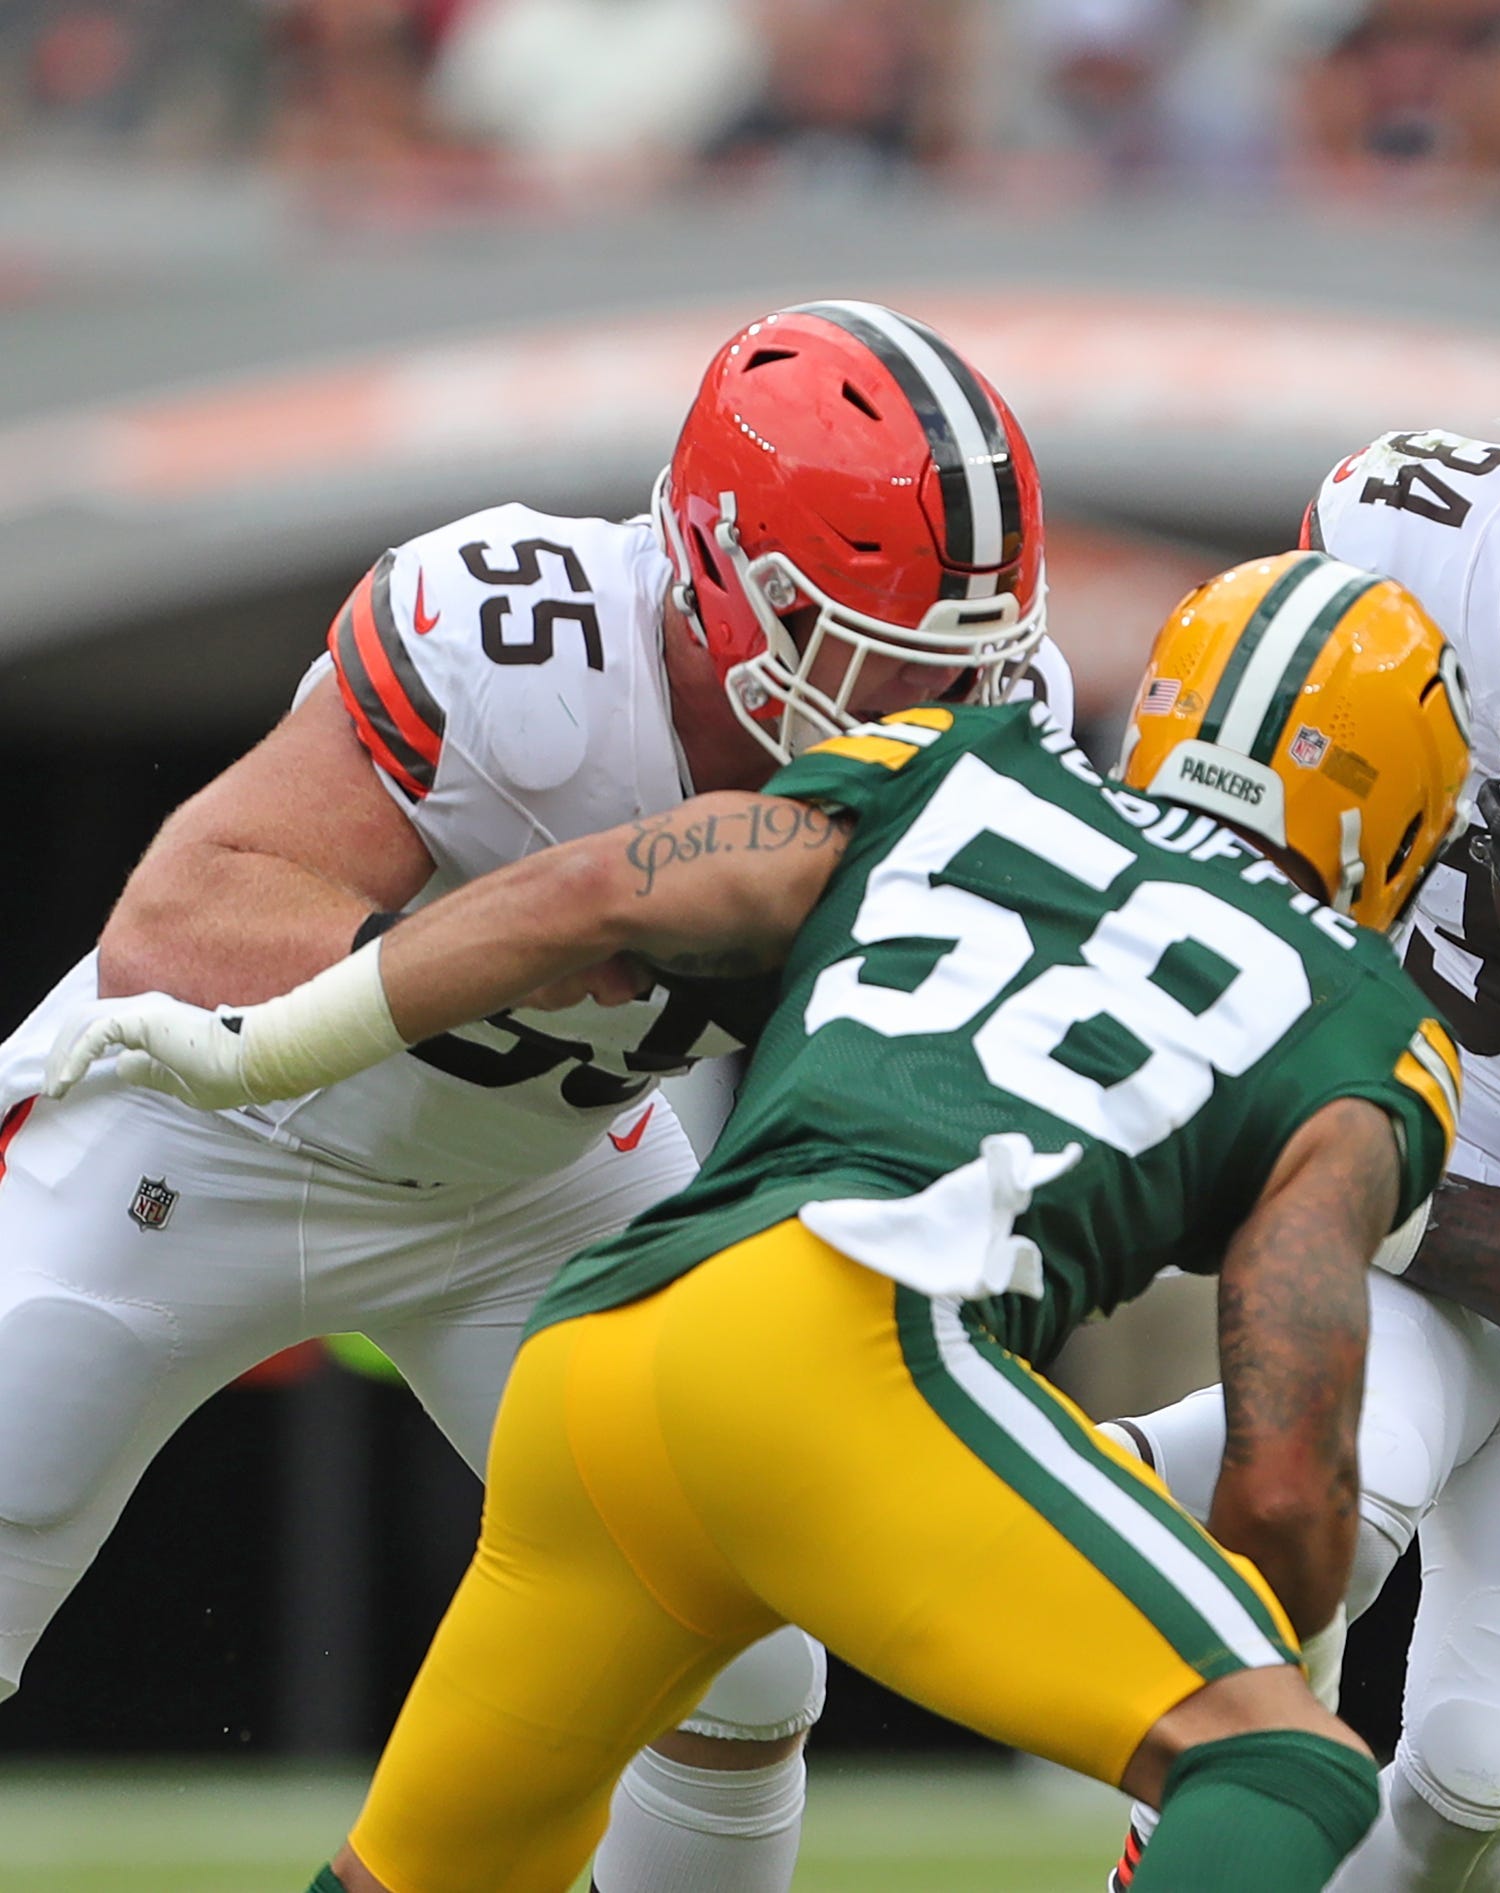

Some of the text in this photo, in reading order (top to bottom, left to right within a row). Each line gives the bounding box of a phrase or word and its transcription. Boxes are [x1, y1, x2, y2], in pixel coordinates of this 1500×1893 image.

[458, 538, 604, 672] 55
[1179, 756, 1266, 806] PACKERS
[738, 803, 853, 857] 199
[804, 752, 1311, 1157] 58
